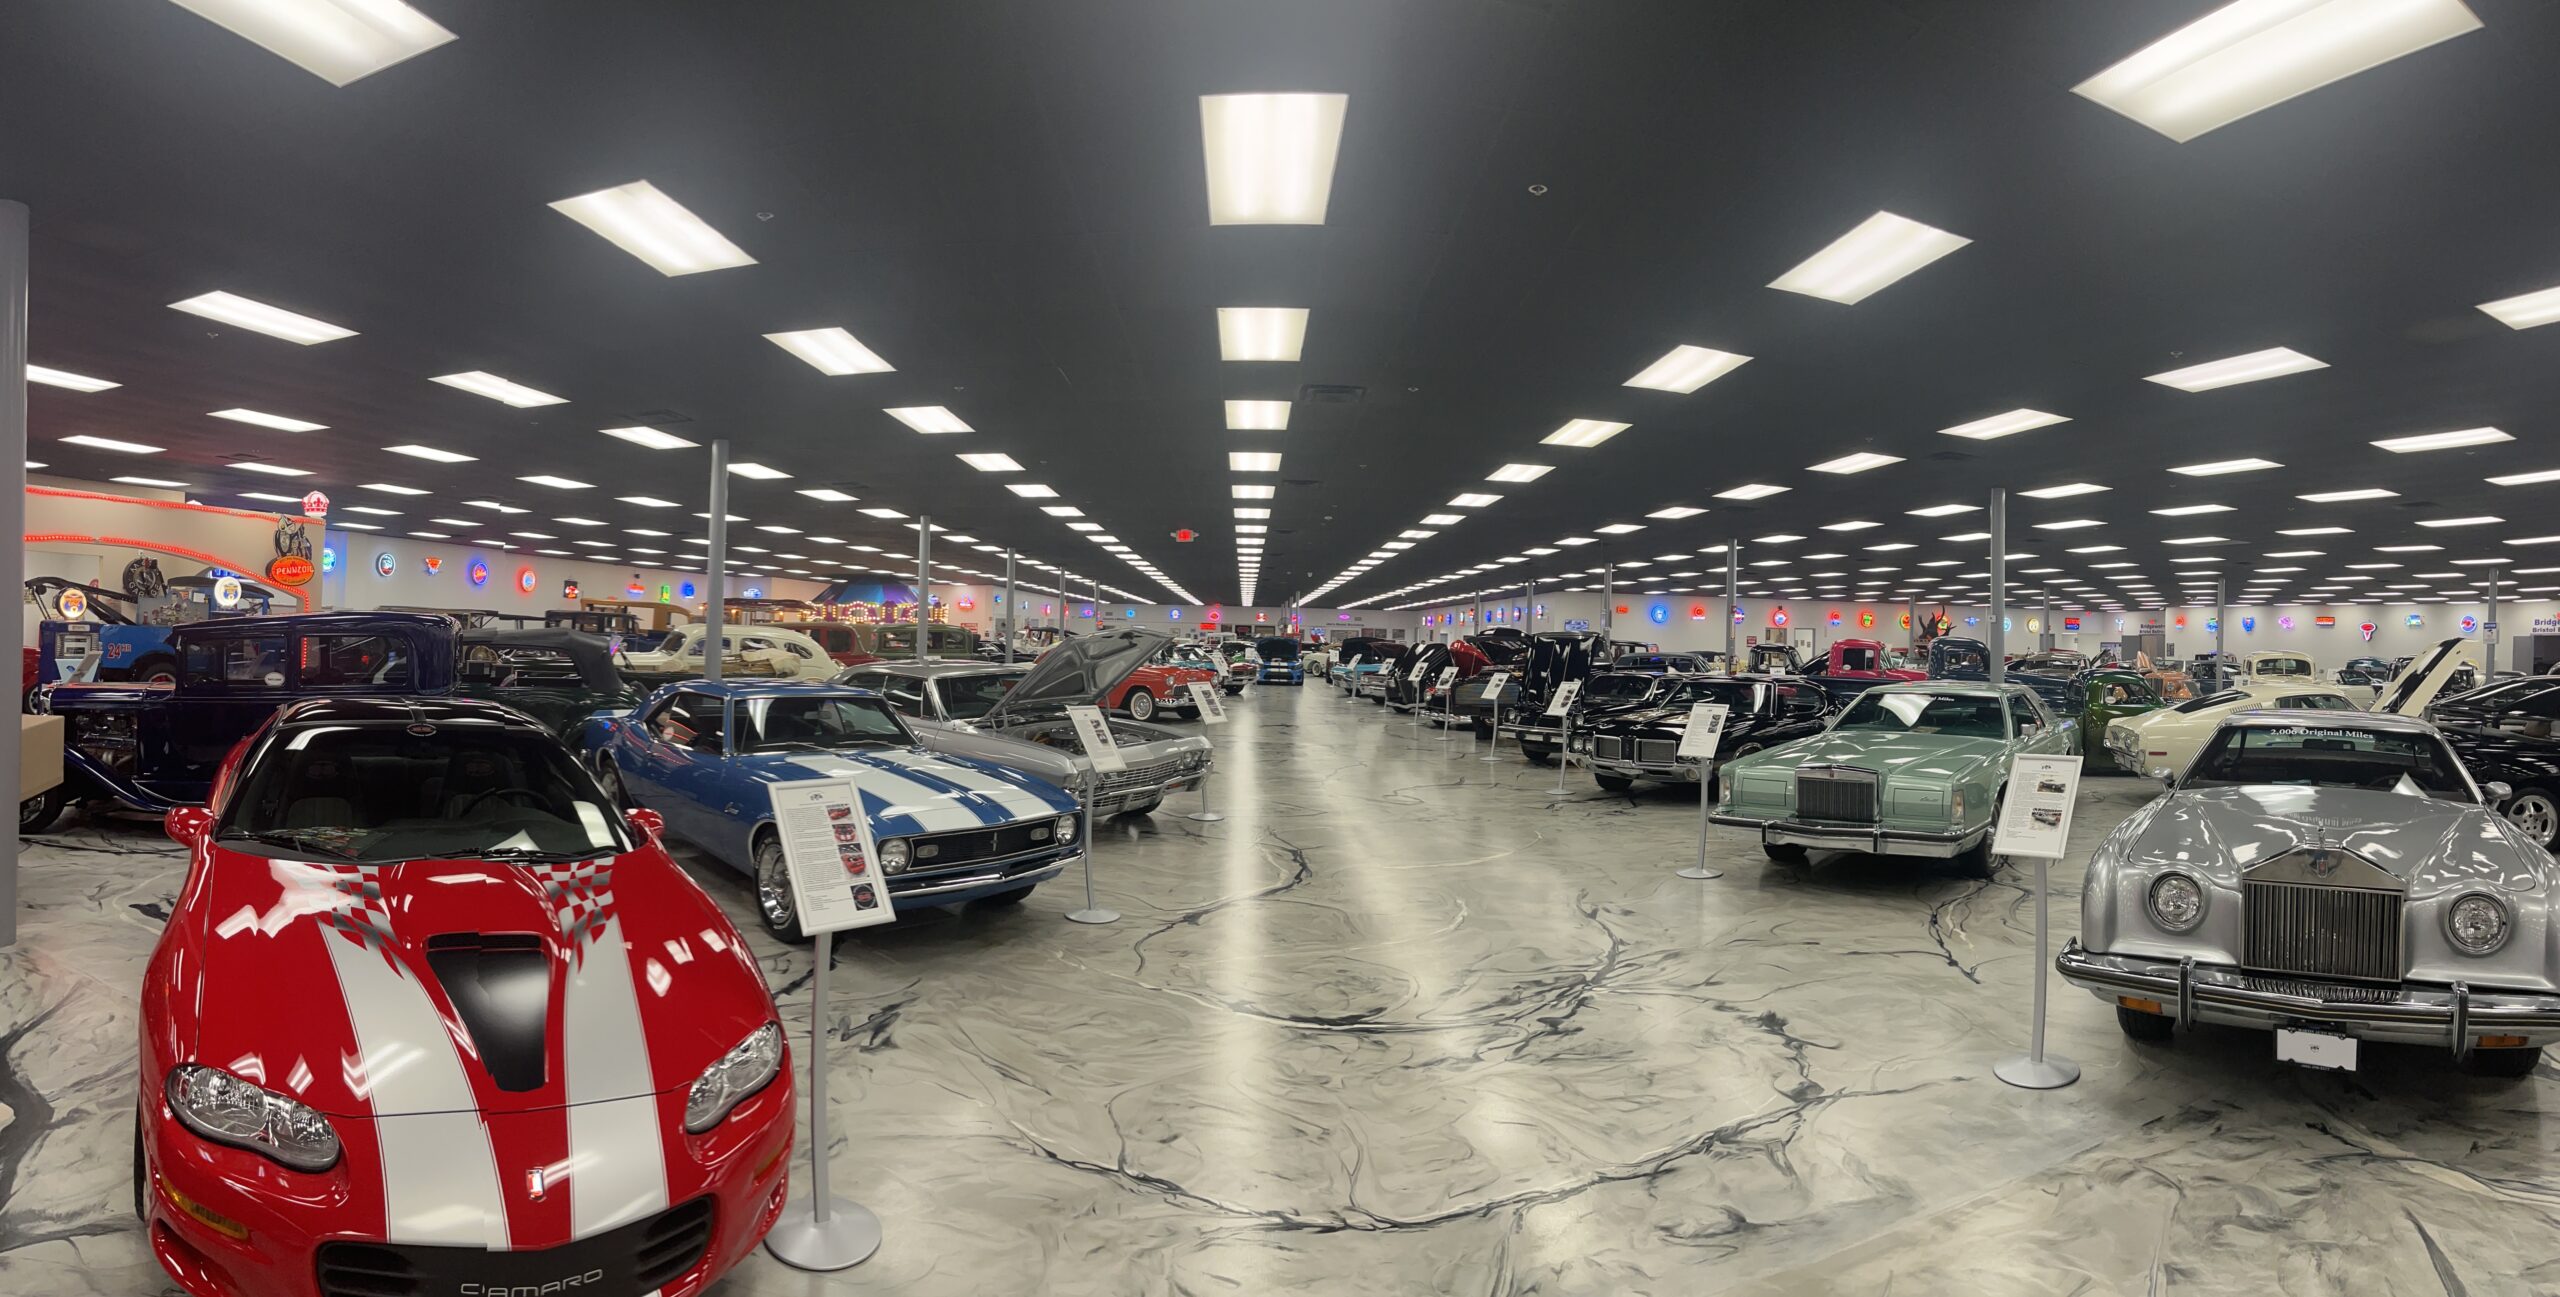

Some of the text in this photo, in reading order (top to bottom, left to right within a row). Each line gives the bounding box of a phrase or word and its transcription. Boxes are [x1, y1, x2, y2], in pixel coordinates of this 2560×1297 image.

[276, 565, 314, 575] PENNZOIL
[2300, 727, 2343, 737] Original
[2345, 730, 2374, 739] Miles
